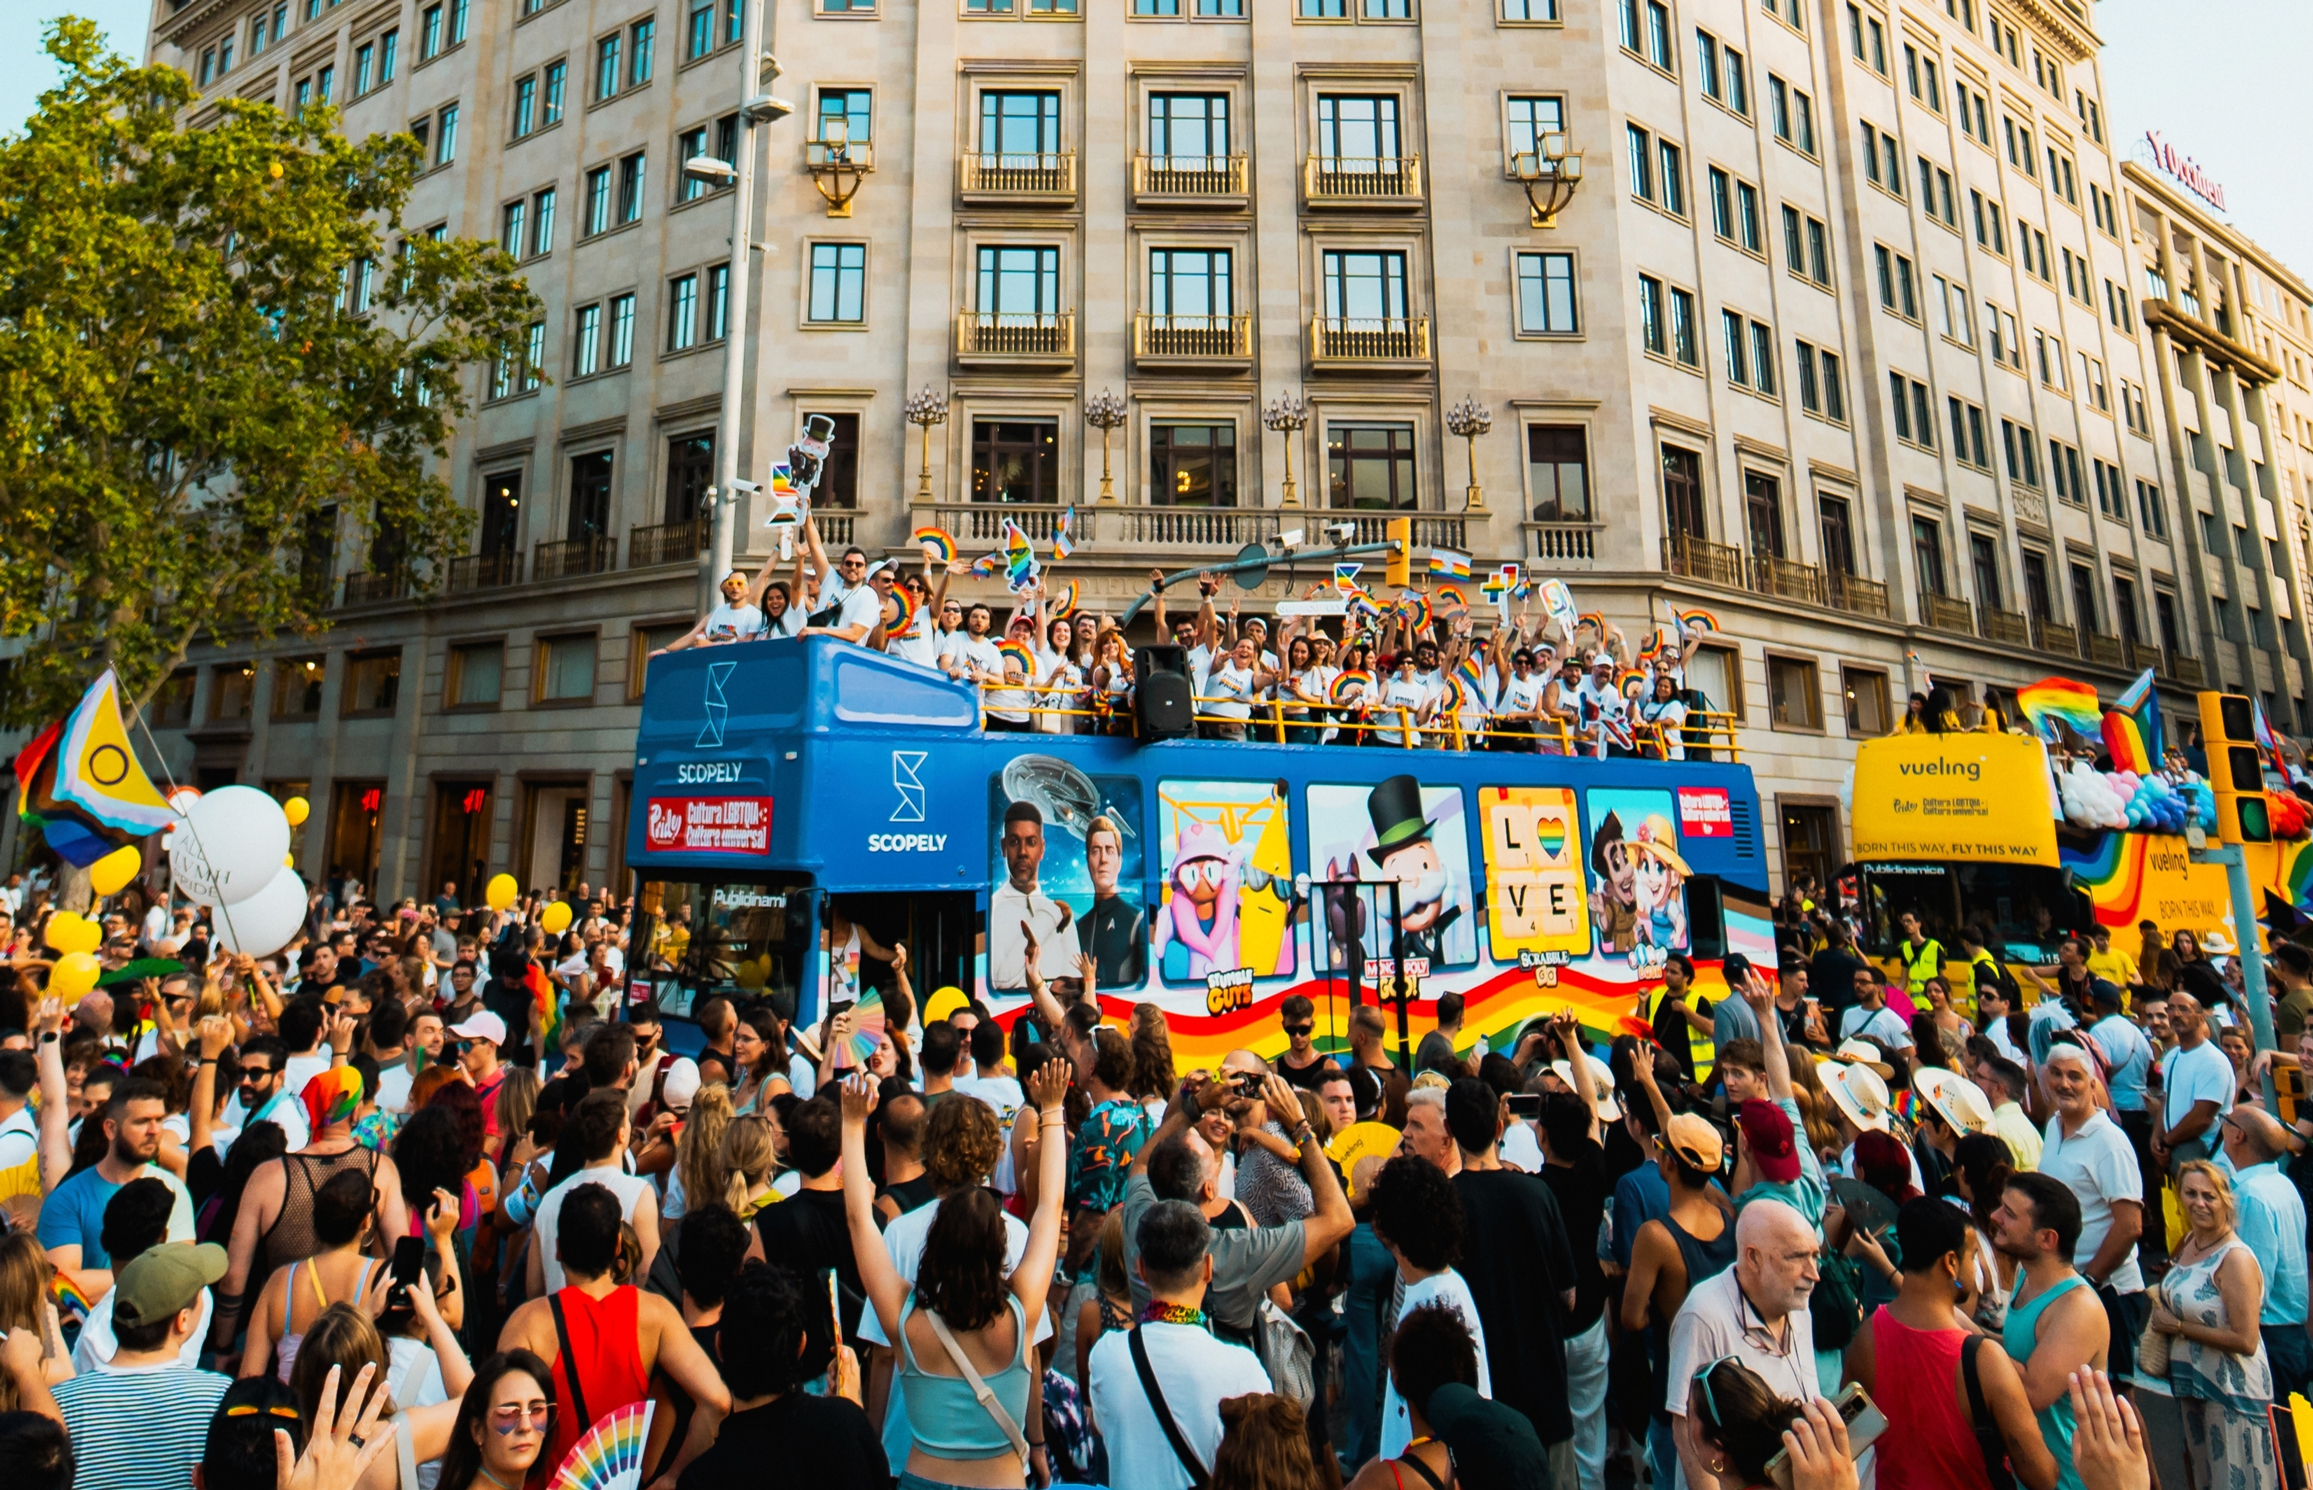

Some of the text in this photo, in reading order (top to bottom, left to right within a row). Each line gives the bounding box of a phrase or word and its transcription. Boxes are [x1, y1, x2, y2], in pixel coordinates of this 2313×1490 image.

[678, 762, 742, 784] SCOPELY
[1899, 755, 1981, 782] vueling
[687, 801, 722, 824] Cultura
[686, 825, 767, 849] Cultura universal
[868, 833, 948, 852] SCOPELY
[1504, 817, 1521, 849] L
[180, 833, 207, 862] ALL
[1856, 842, 2039, 857] BORN THIS WAY, FLY THIS WAY
[174, 850, 232, 885] LVMH
[2149, 842, 2188, 882] vueling
[173, 867, 219, 899] PRIDE
[713, 888, 787, 908] Publidinami
[1508, 883, 1567, 917] V E
[2159, 899, 2183, 920] BORN
[2182, 899, 2201, 919] THIS
[1520, 950, 1570, 968] SCRABBLE
[1207, 968, 1253, 989] STUMBLE
[1207, 983, 1253, 1015] GUYS
